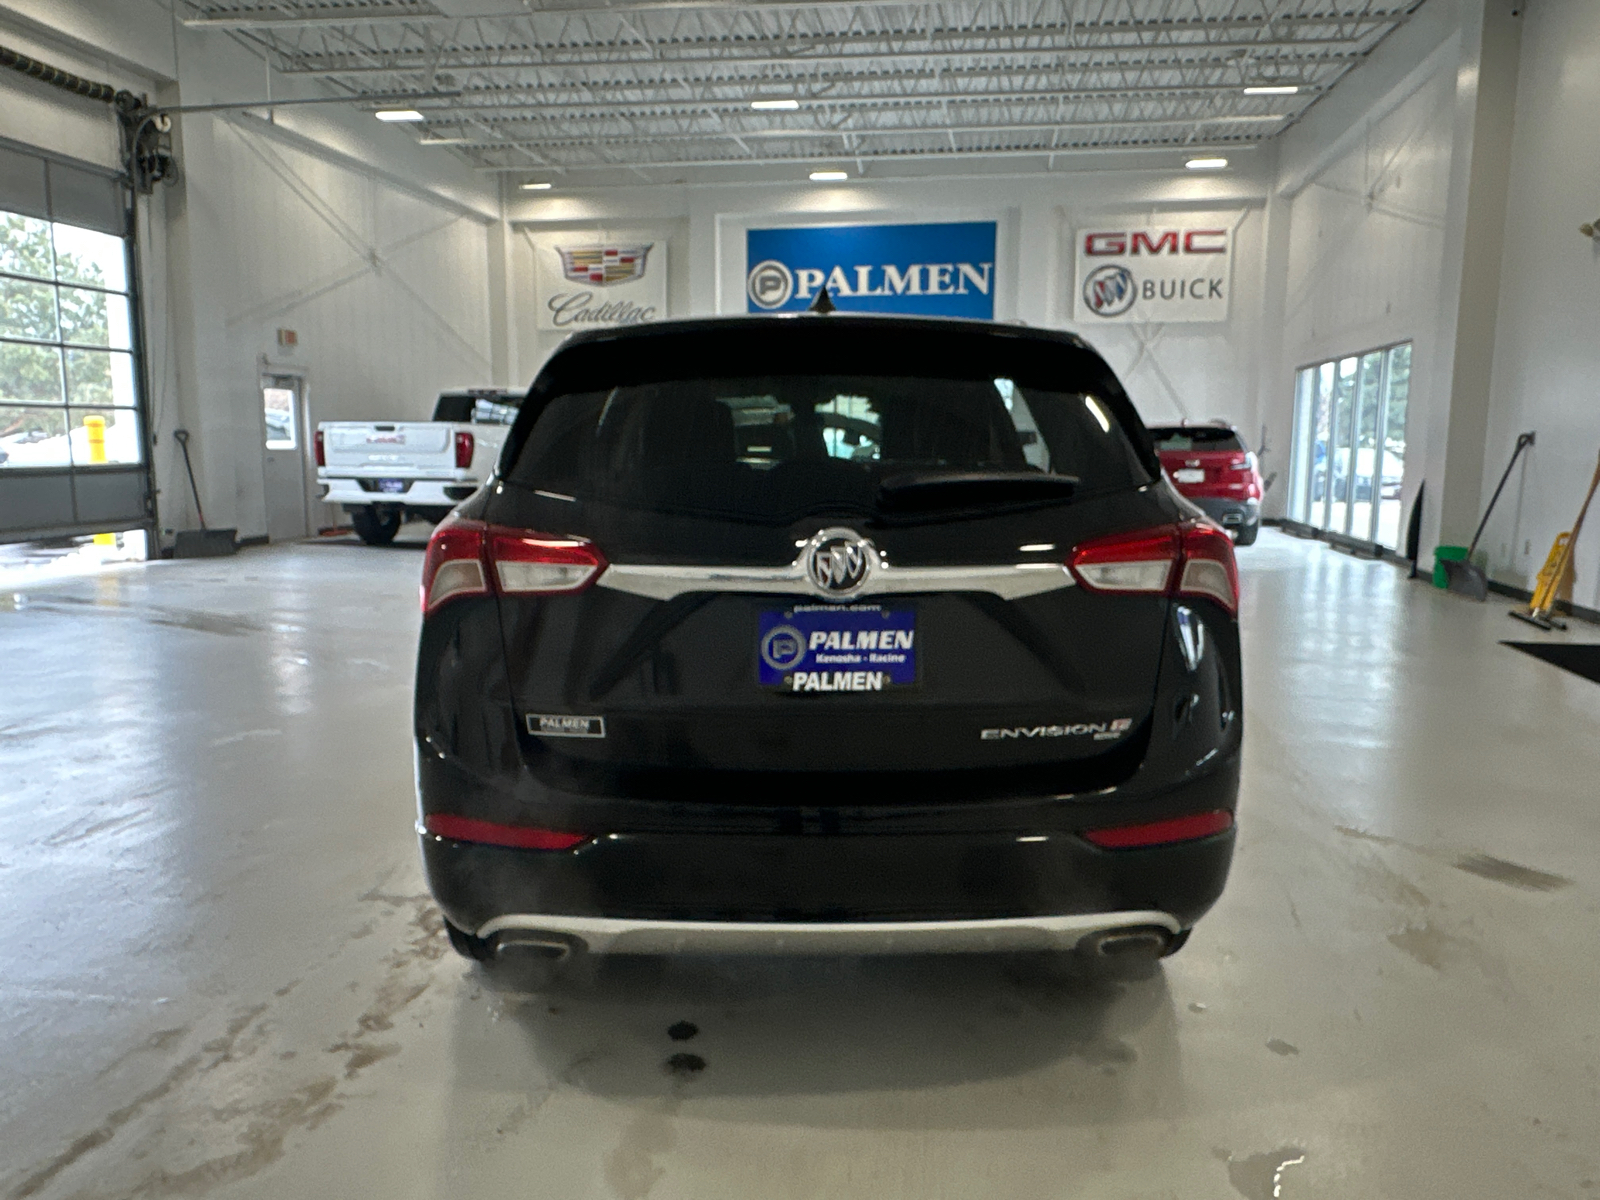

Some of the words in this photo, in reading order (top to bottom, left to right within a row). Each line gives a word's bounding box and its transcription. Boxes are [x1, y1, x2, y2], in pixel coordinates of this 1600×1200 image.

[1085, 229, 1227, 257] GMC
[794, 262, 993, 299] PALMEN
[1141, 278, 1224, 300] BUICK
[547, 291, 657, 327] Cadillac
[808, 630, 915, 651] PALMEN
[815, 653, 861, 664] Kenosha
[869, 653, 905, 664] Racine
[792, 671, 884, 692] PALMEN
[980, 722, 1107, 740] ENVISION
